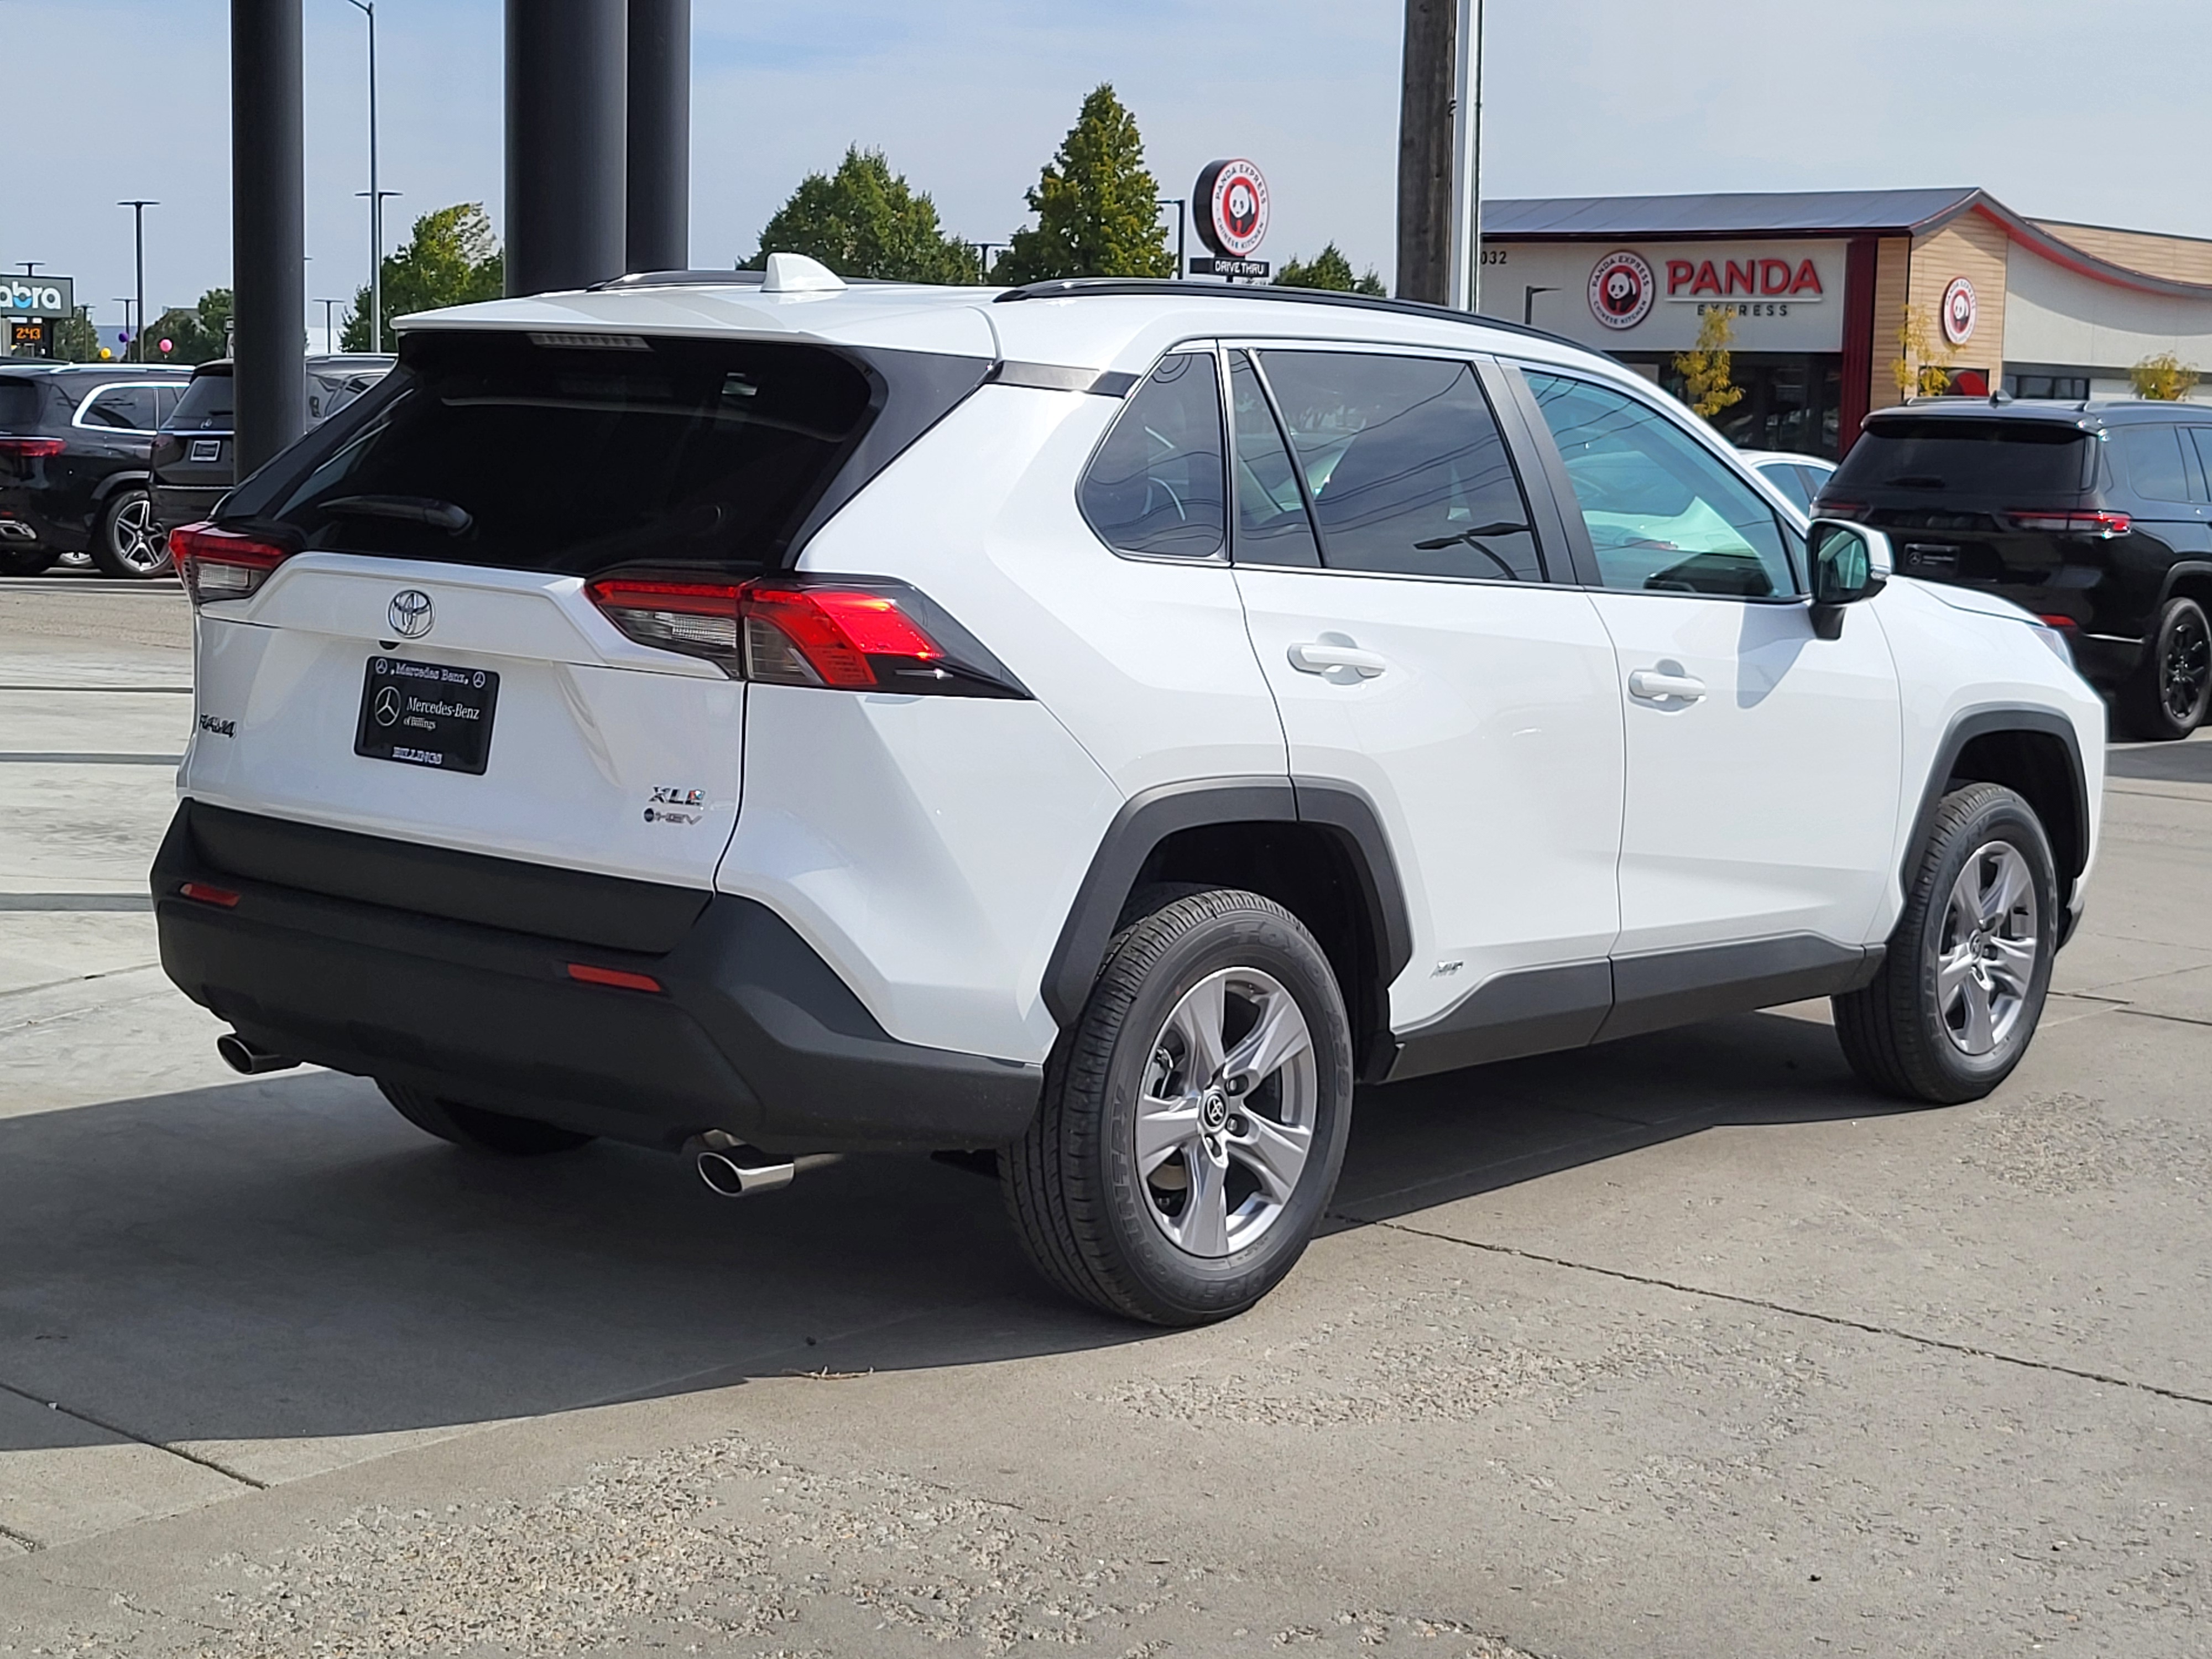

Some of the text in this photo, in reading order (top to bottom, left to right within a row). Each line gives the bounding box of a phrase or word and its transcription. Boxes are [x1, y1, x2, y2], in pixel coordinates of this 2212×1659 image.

[1215, 164, 1266, 204] PANDA EXPRESS
[1215, 260, 1264, 275] DRIVE THRU
[1592, 255, 1650, 287] PANDA EXPRESS
[1666, 259, 1823, 295] PANDA
[0, 281, 62, 309] abra
[395, 662, 440, 680] Mercedes
[406, 696, 480, 719] Mercedes-Benz
